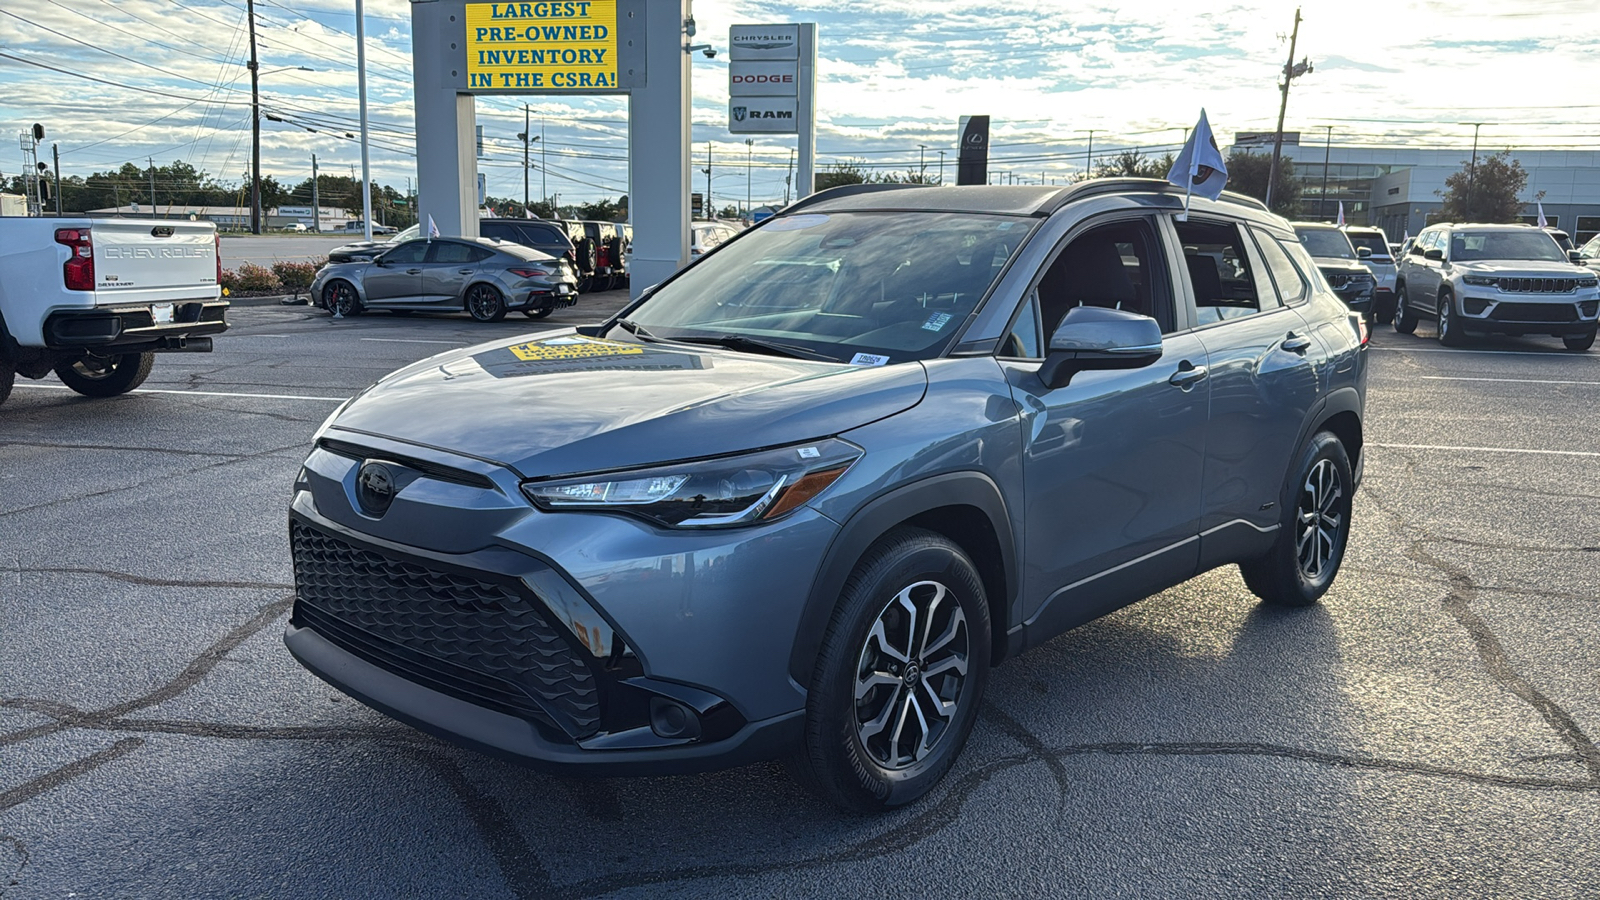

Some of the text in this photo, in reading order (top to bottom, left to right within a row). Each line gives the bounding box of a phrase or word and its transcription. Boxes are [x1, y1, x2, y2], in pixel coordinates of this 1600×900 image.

[491, 2, 591, 18] LARGEST
[476, 26, 608, 41] PRE-OWNED
[478, 49, 607, 64] INVENTORY
[470, 72, 615, 87] IN THE CSRA!
[733, 75, 793, 83] DODGE
[750, 111, 792, 119] RAM
[105, 247, 211, 259] CHEVROLET
